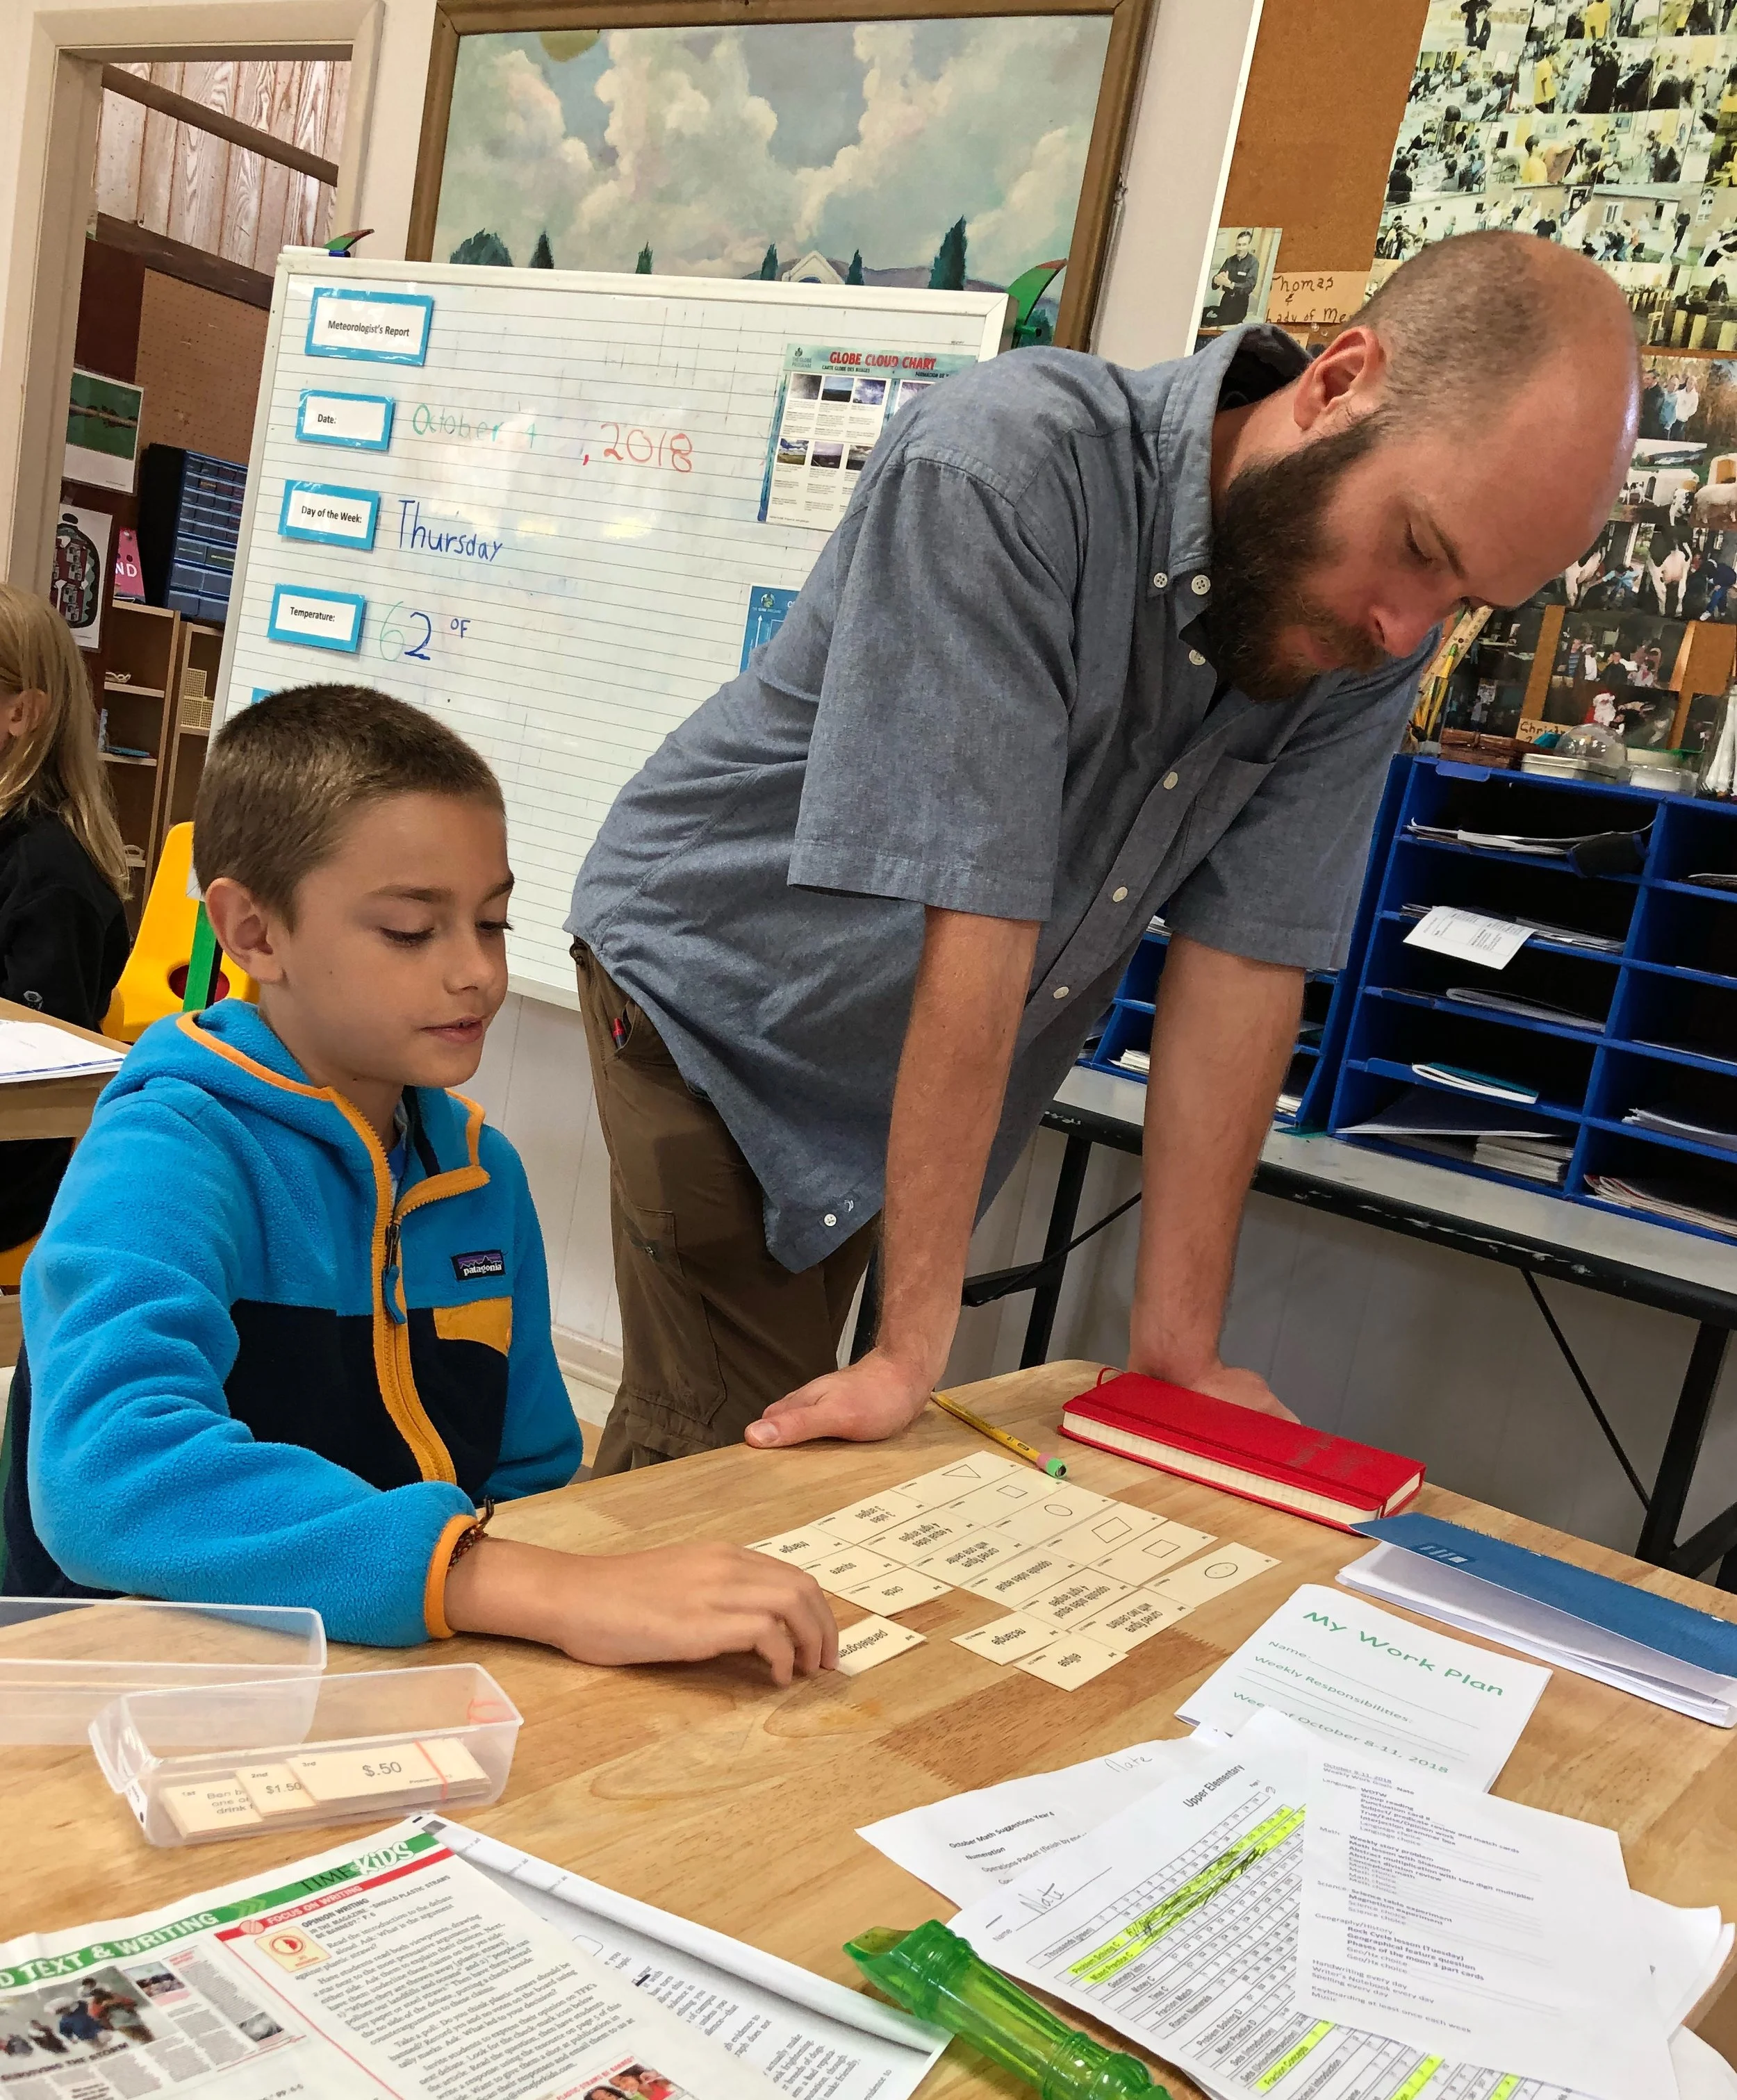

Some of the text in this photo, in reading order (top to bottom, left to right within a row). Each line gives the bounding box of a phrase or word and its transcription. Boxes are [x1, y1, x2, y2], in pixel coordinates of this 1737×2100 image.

[1303, 308, 1316, 322] of
[327, 320, 410, 337] Meteorologist's Report
[829, 352, 937, 370] GLOBE CLOUD CHART
[317, 413, 337, 424] Date:
[412, 403, 503, 443] October
[302, 505, 362, 524] Day of the Week:
[397, 499, 503, 562] Thursday
[290, 606, 336, 622] Temperature:
[379, 601, 431, 661] 62
[463, 1263, 502, 1277] patagonia
[779, 1541, 809, 1553] triangle
[829, 1562, 857, 1574] square
[881, 1585, 903, 1596] circle
[991, 1628, 1026, 1645] rectangle
[1268, 1641, 1312, 1660] Name:
[1302, 1611, 1504, 1696] My Work Plan
[1057, 1653, 1081, 1667] ellipse
[1254, 1655, 1414, 1723] Weekly Responsibilities:
[1233, 1691, 1267, 1709] Wee
[1297, 1716, 1362, 1742] October
[1364, 1739, 1402, 1758] 8-11,
[1408, 1755, 1449, 1774] 2018
[361, 1761, 403, 1778] $.50
[1104, 1755, 1153, 1773] Nate
[265, 1781, 302, 1795] $1.50
[1183, 1764, 1244, 1807] Upper Elementary
[949, 1838, 976, 1849] October
[975, 1832, 996, 1844] Math
[995, 1816, 1035, 1835] Suggestions
[1033, 1812, 1050, 1823] Year
[965, 1846, 1006, 1860] Numeration
[1017, 1850, 1042, 1865] Packet
[299, 1865, 354, 1893] TIME
[267, 1885, 364, 1926] FOCUS ON WRITING
[1018, 1883, 1064, 1915] Nate
[301, 1898, 369, 1928] OPINION WRITING
[22, 1953, 86, 1983] TEXT
[93, 1940, 115, 1961] &
[110, 1912, 220, 1958] WRITING
